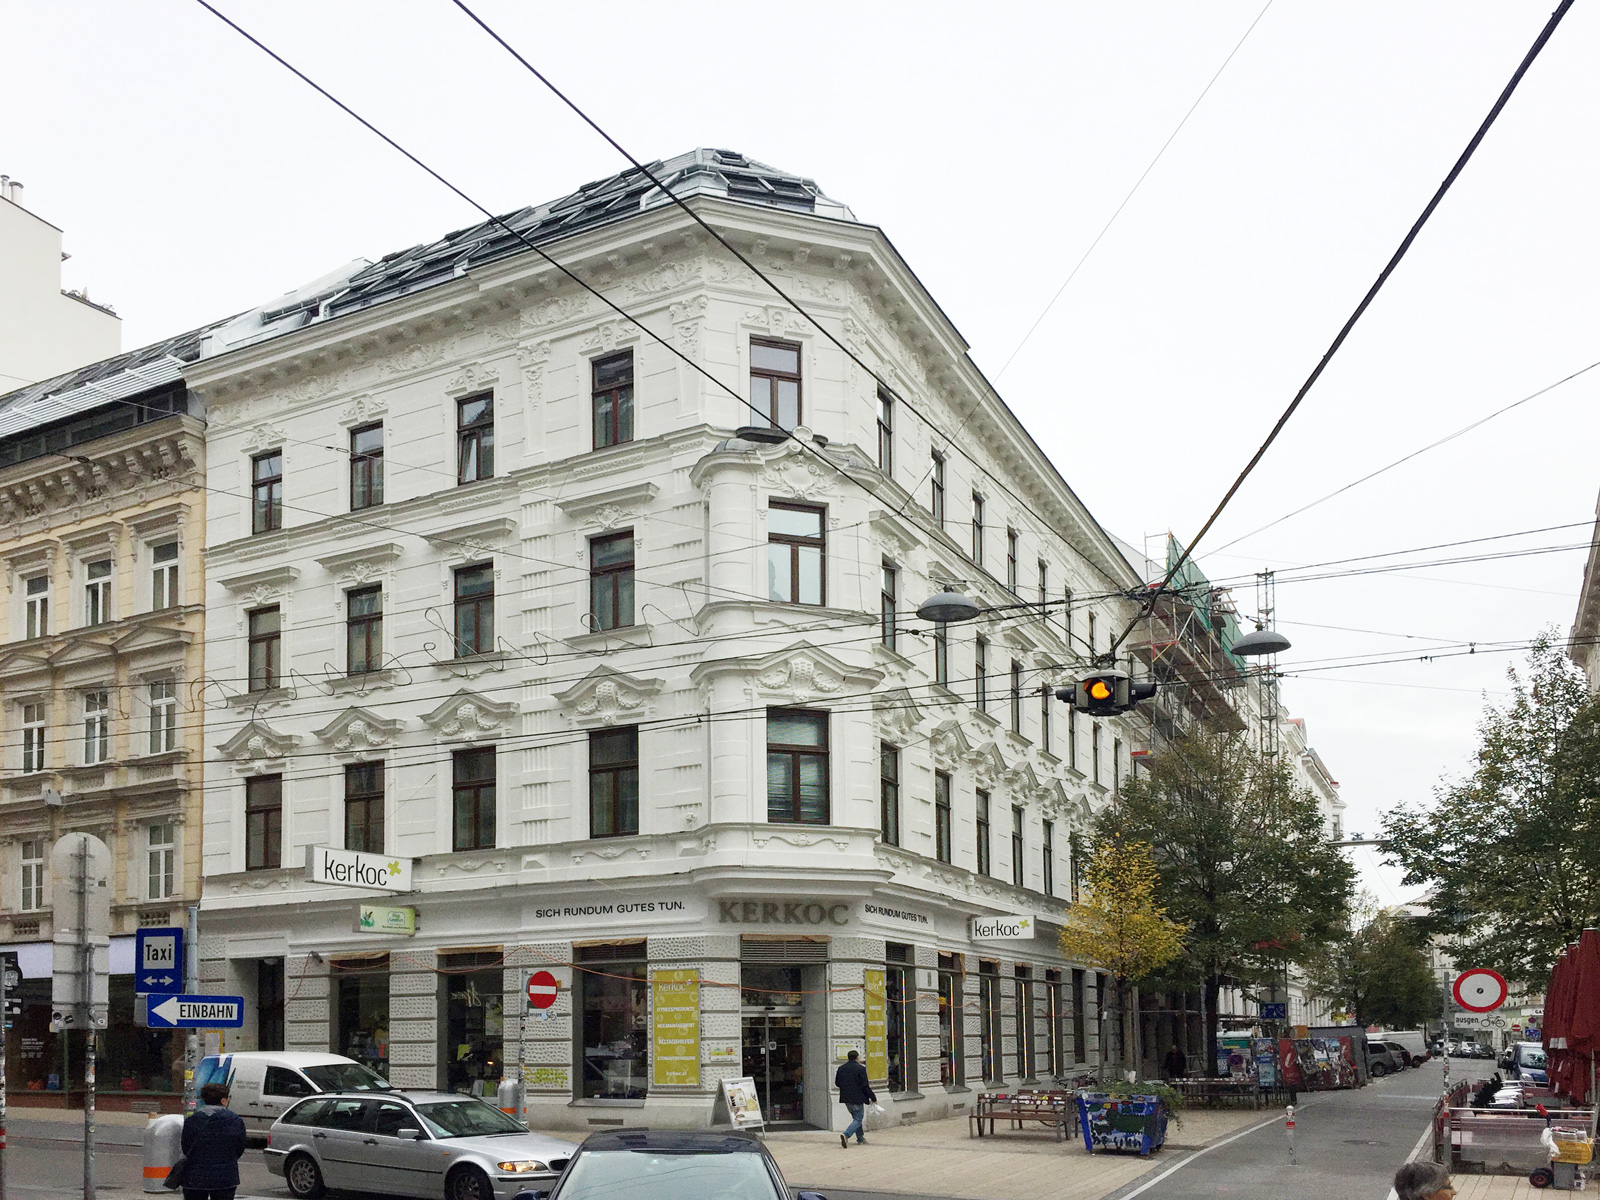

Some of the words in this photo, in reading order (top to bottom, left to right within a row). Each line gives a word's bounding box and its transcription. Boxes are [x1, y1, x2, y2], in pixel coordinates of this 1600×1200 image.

[535, 908, 561, 919] SICH
[563, 905, 614, 917] RUNDUM
[616, 902, 656, 914] GUTES
[657, 900, 686, 911] TUN.
[718, 901, 849, 926] KERKOC
[864, 903, 878, 914] SICH
[878, 906, 901, 918] RUNDUM
[901, 911, 918, 922] GUTES
[145, 943, 173, 961] Taxi
[179, 1004, 234, 1018] EINBAHN
